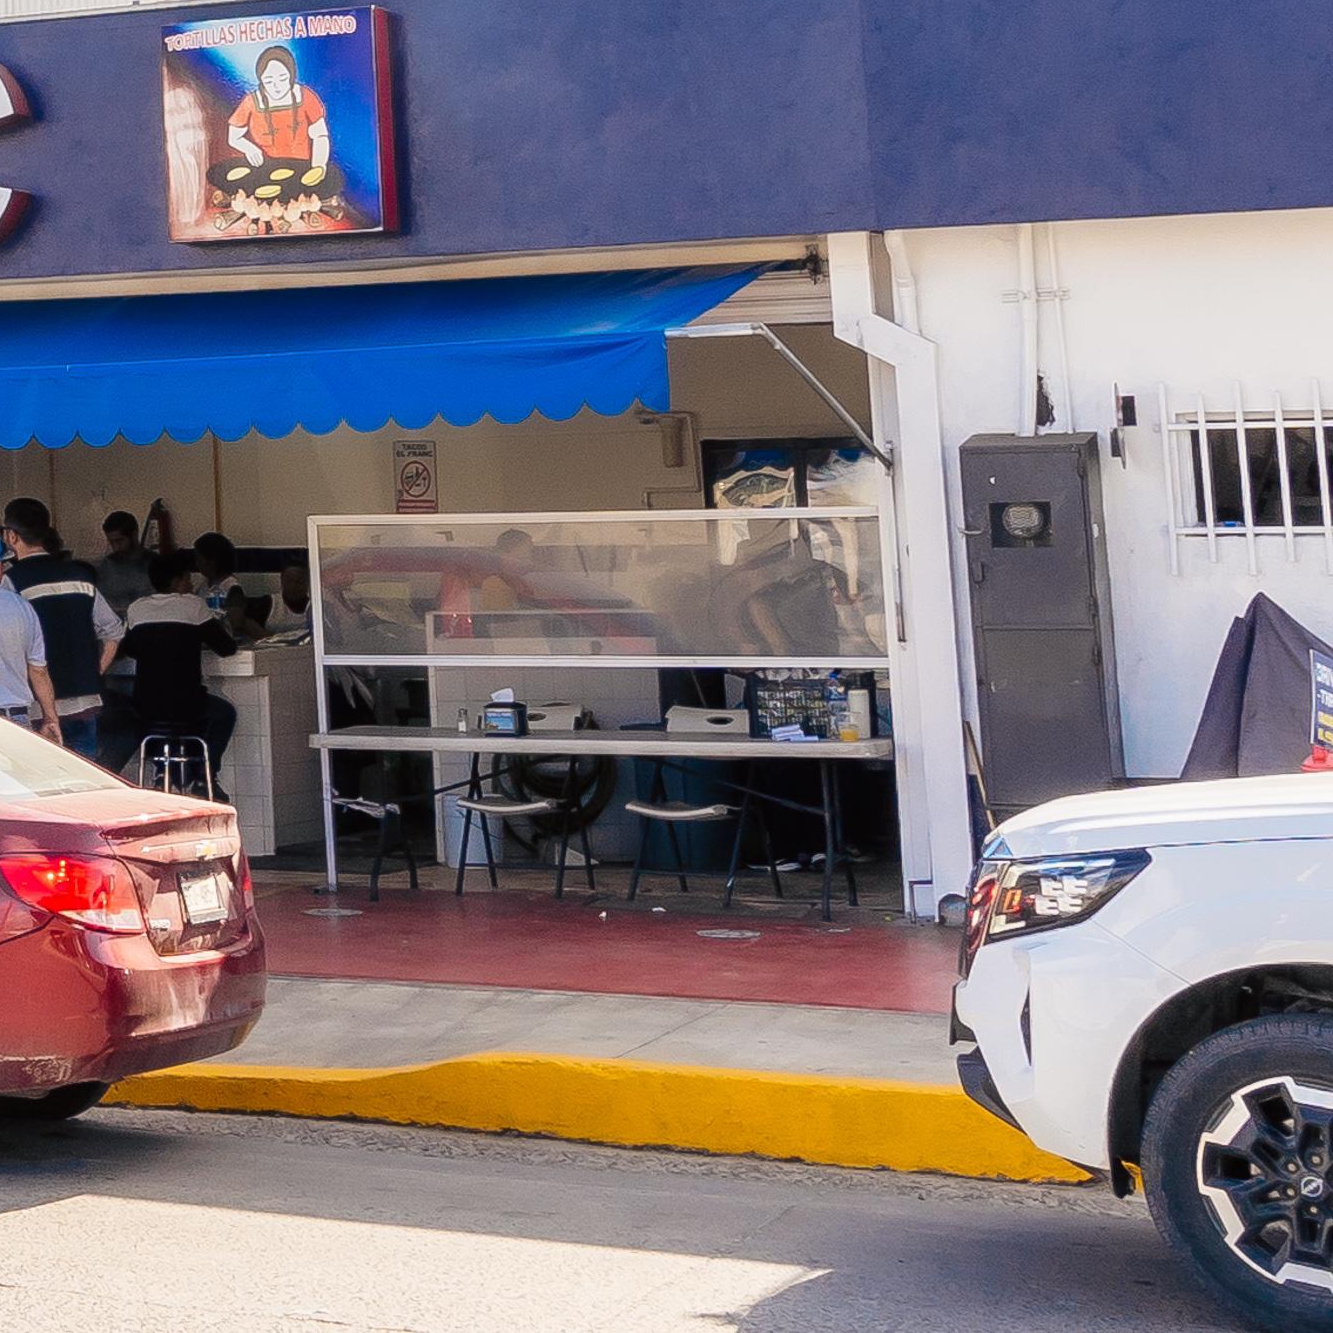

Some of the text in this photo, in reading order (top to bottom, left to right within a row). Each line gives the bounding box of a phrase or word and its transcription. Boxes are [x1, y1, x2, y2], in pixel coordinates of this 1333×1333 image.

[164, 14, 357, 52] TORTILLAS HECHAS A MANO
